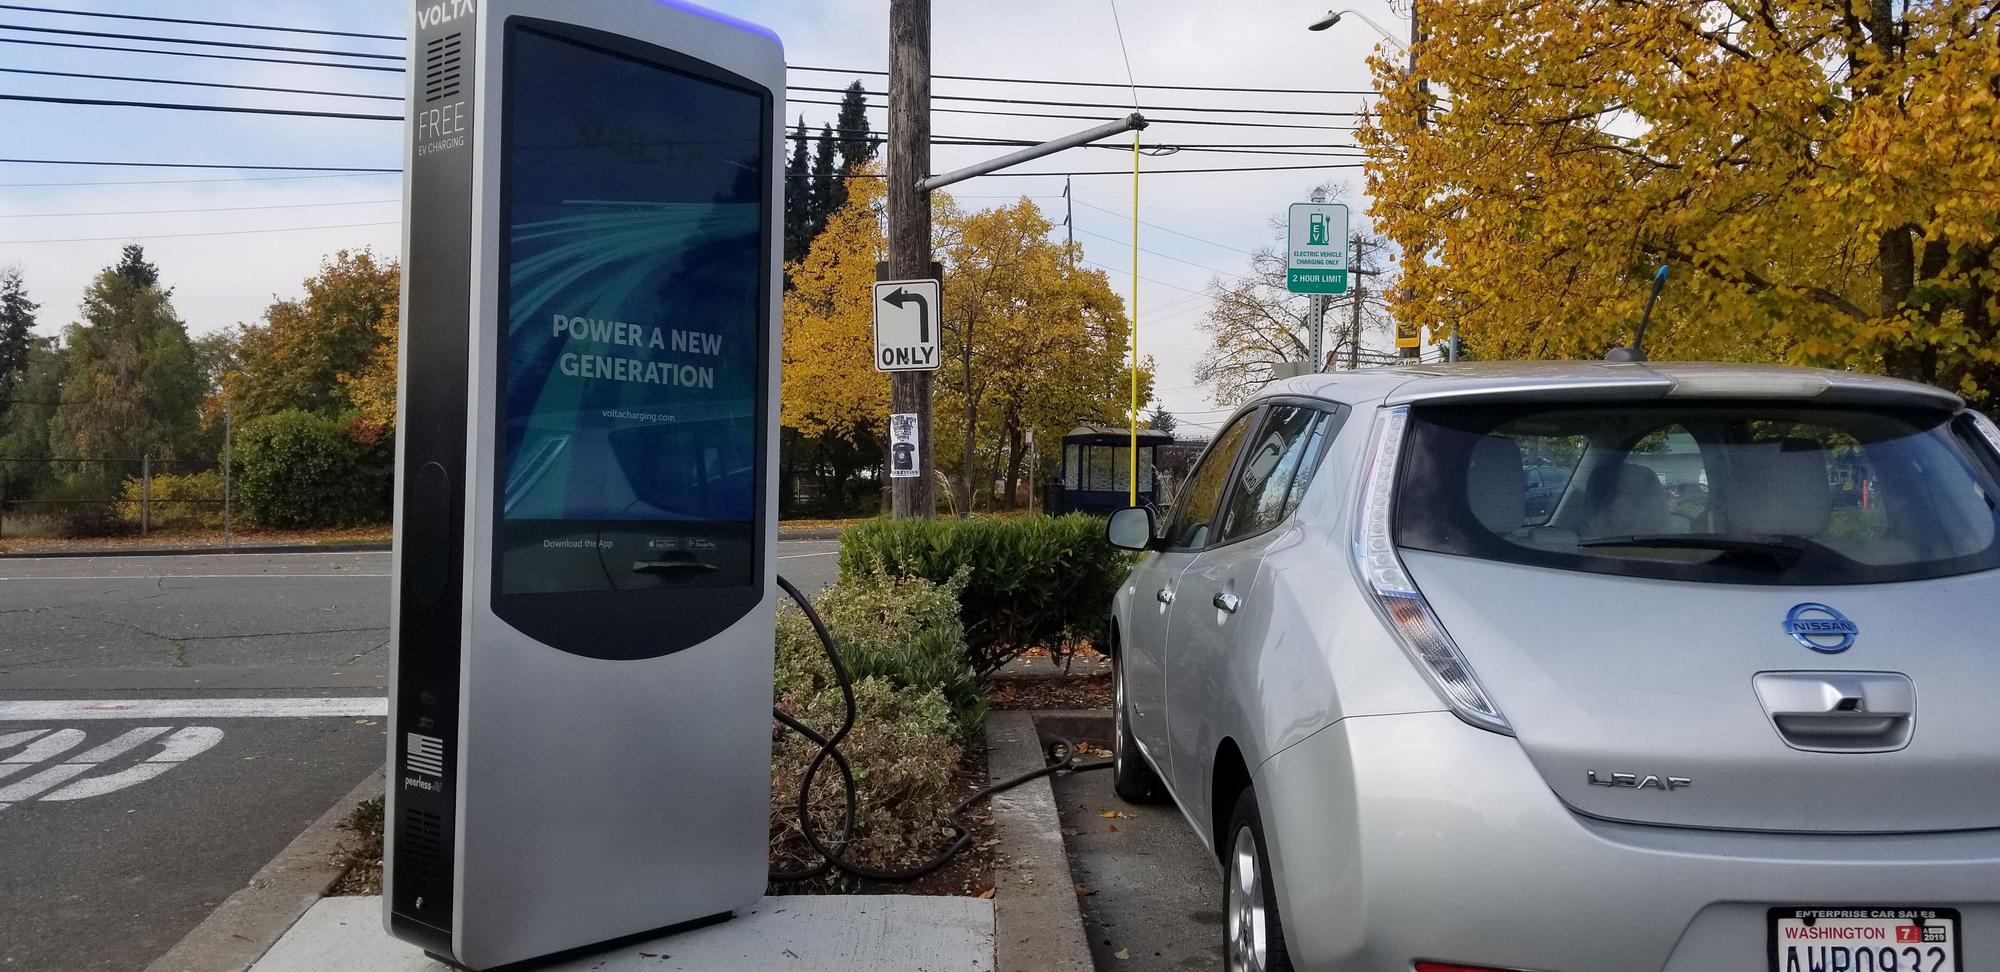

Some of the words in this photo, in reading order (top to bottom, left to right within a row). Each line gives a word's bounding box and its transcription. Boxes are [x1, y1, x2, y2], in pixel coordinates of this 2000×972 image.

[418, 0, 473, 29] VOLTA
[419, 101, 464, 141] FREE
[418, 145, 428, 156] EV
[428, 135, 465, 154] CHARGING
[1292, 274, 1298, 282] 2
[1321, 275, 1342, 283] LIMIT
[553, 314, 643, 347] POWER
[649, 327, 665, 350] A
[671, 329, 722, 356] NEW
[882, 346, 934, 366] ONLY
[560, 352, 714, 389] GENERATION
[602, 409, 676, 424] voltacharging.com
[543, 539, 583, 548] Download
[585, 539, 597, 548] the
[598, 539, 614, 549] App
[1793, 622, 1852, 631] NISSAN
[1587, 770, 1691, 791] LEAF
[1795, 910, 1868, 918] ENTERPRISE
[1871, 910, 1895, 918] CAR
[1785, 927, 1885, 939] WASHINGTON
[1902, 928, 1911, 940] 7
